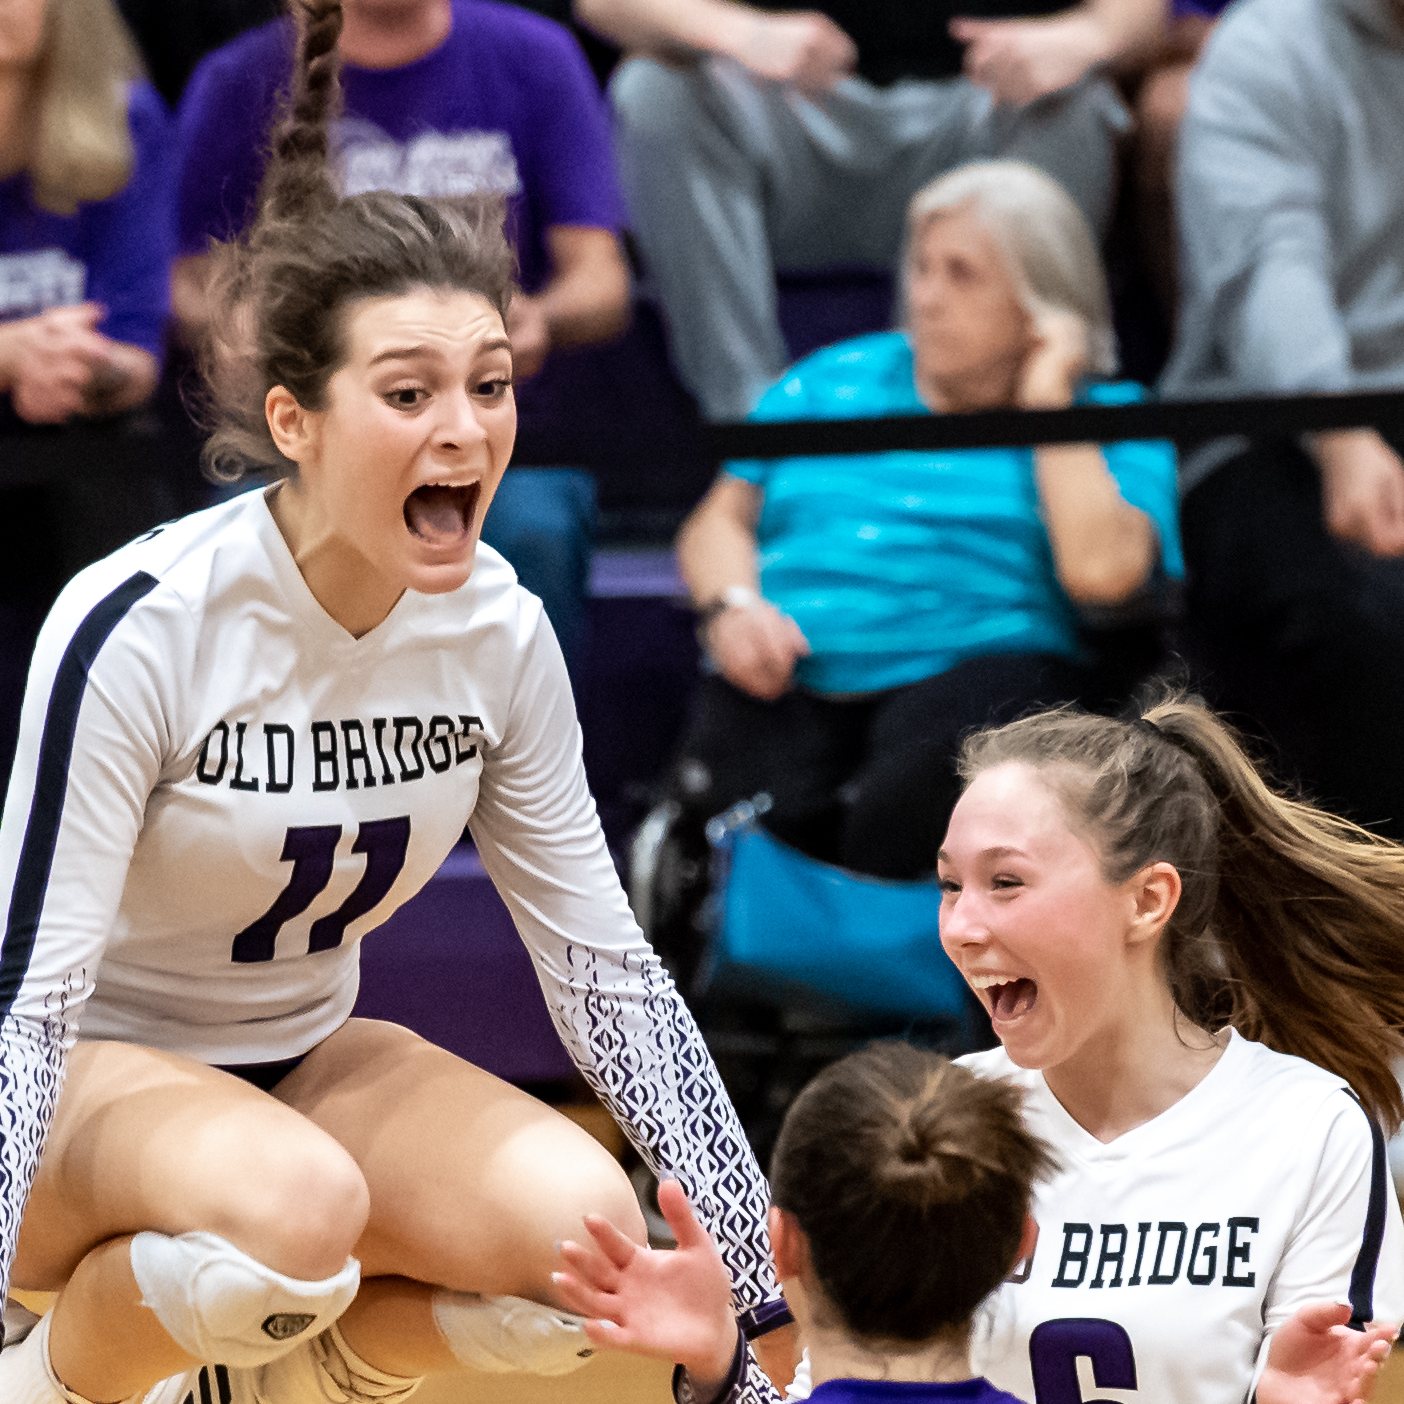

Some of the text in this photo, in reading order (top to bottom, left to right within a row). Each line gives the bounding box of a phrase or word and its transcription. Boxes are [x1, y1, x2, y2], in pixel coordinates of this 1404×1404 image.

[197, 714, 486, 794] OLD BRIDGE
[230, 815, 412, 964] 11
[1050, 1216, 1260, 1289] BRIDGE
